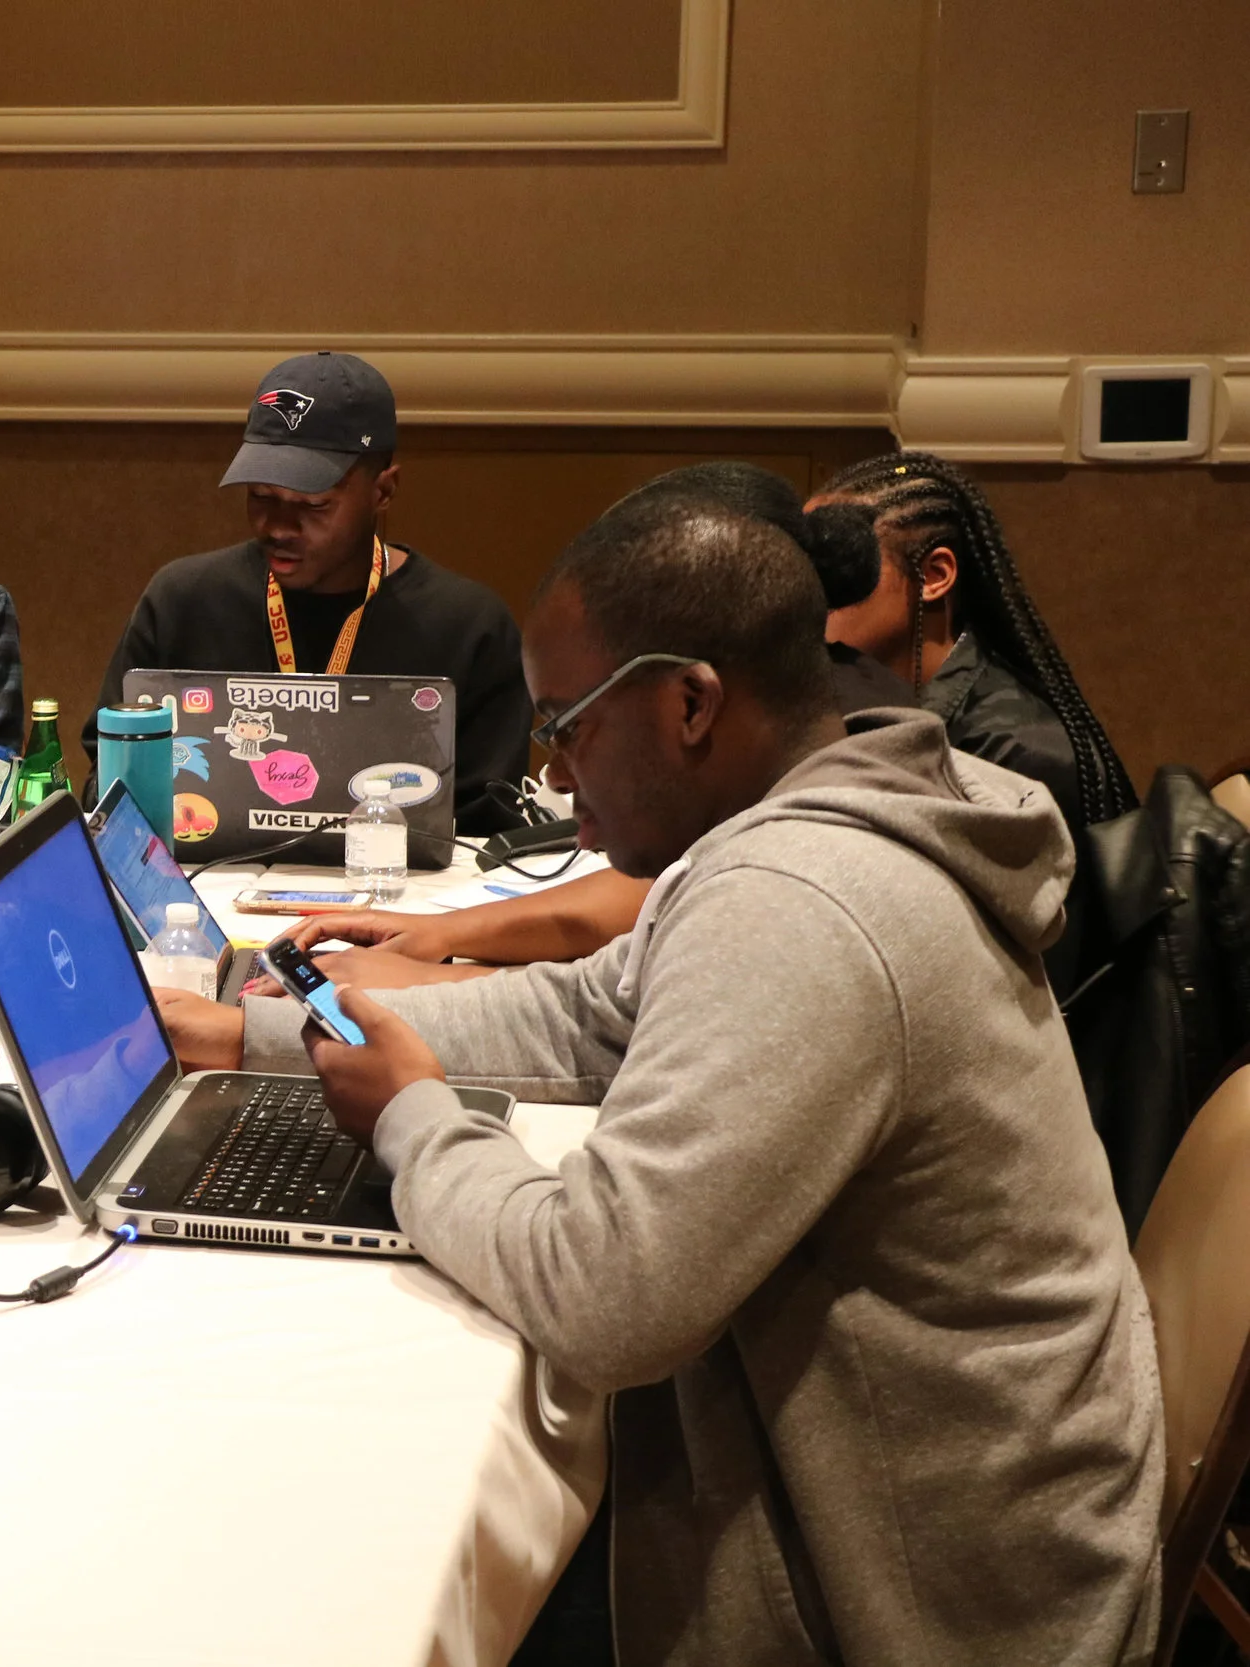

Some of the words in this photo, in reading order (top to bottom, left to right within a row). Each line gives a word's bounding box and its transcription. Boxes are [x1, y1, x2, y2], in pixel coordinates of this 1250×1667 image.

[270, 604, 289, 645] USC
[230, 687, 336, 710] blubeta
[264, 762, 310, 789] Sexy
[253, 813, 348, 829] VICELAN
